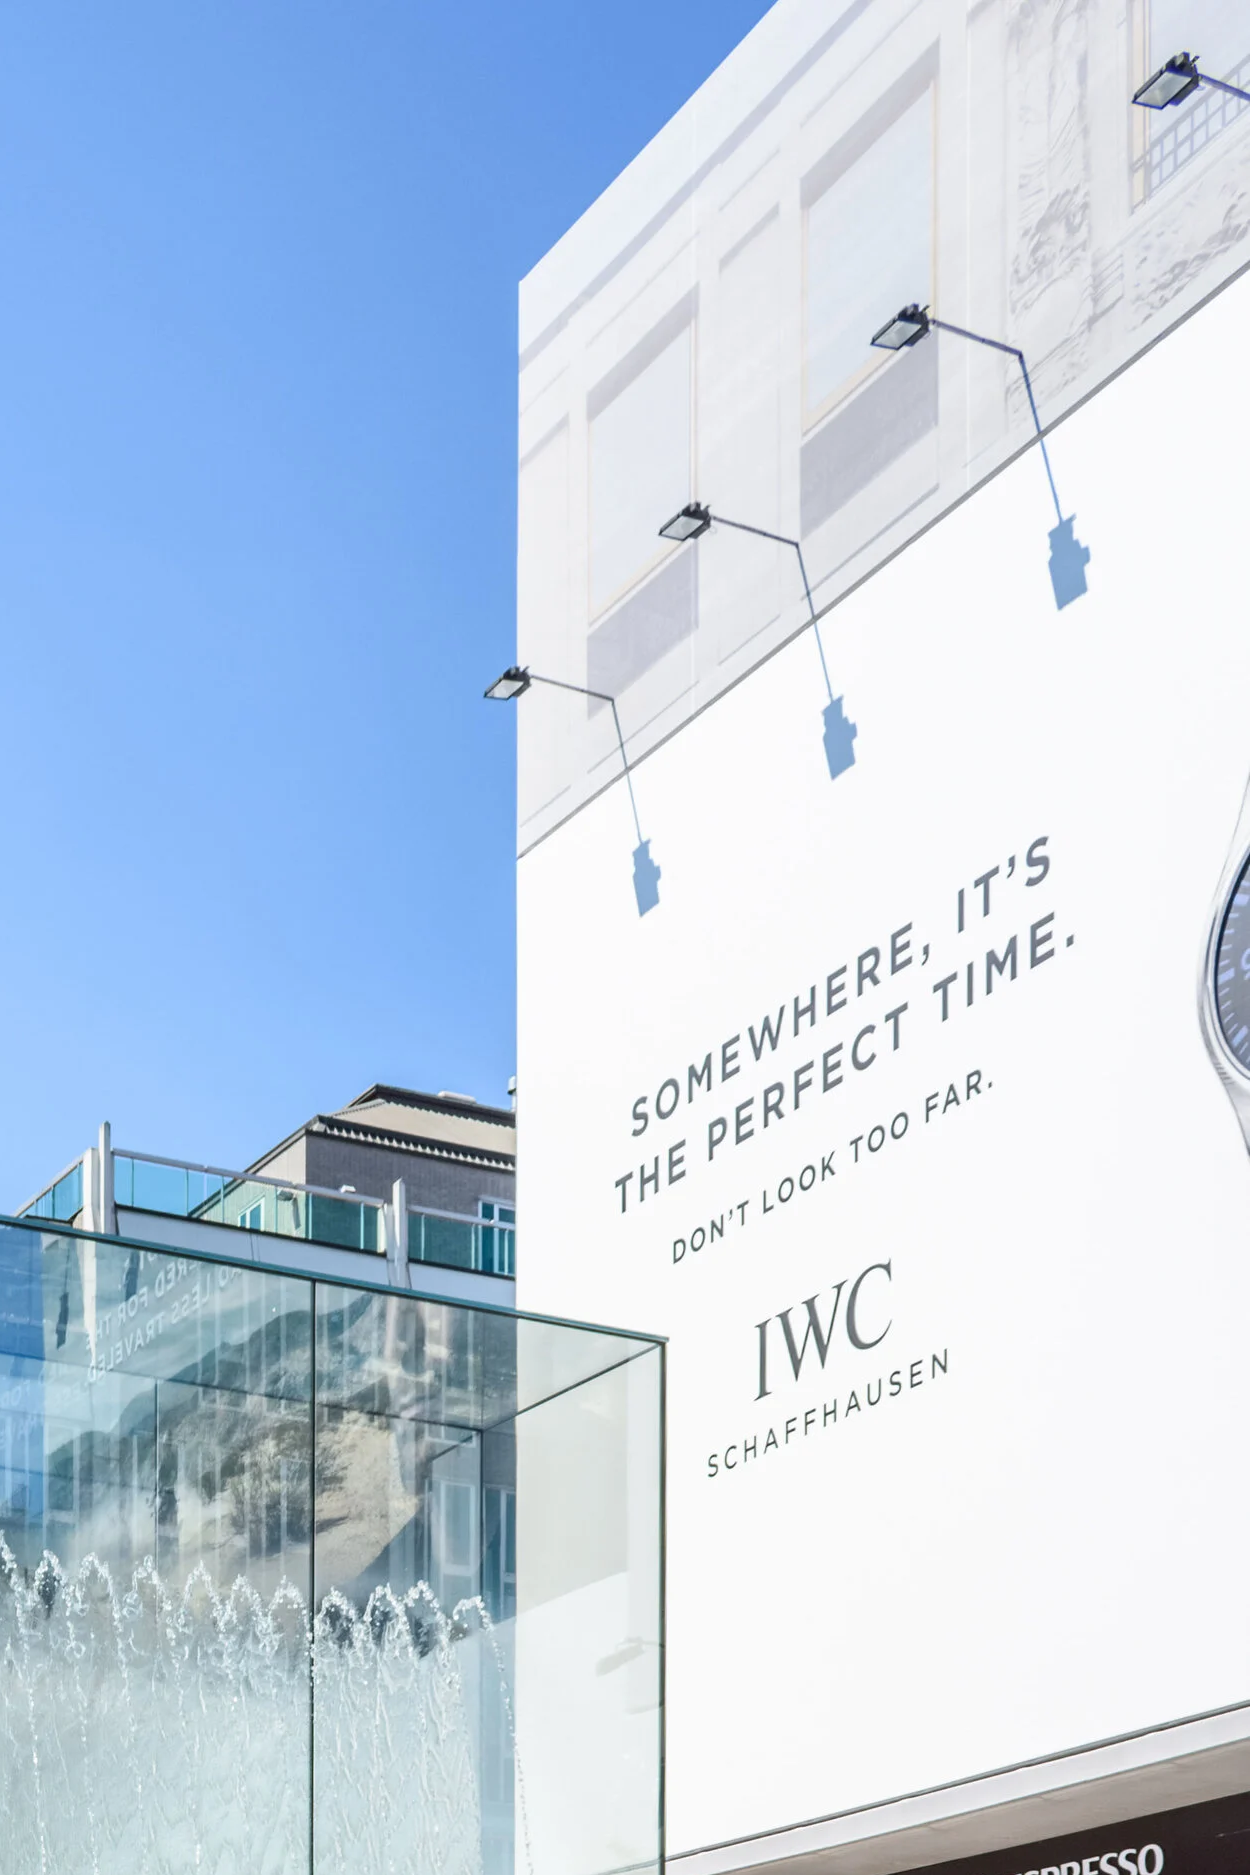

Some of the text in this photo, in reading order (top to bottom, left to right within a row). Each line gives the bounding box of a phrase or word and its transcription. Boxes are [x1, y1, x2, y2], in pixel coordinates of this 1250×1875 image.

[614, 911, 1075, 1214] THE PERFECT TIME.
[632, 836, 1051, 1137] SOMEWHERE, IT'S
[672, 1069, 993, 1265] DON'T LOOK TOO FAR.
[707, 1348, 948, 1478] SCHAFFHAUSEN
[753, 1259, 892, 1402] IWC
